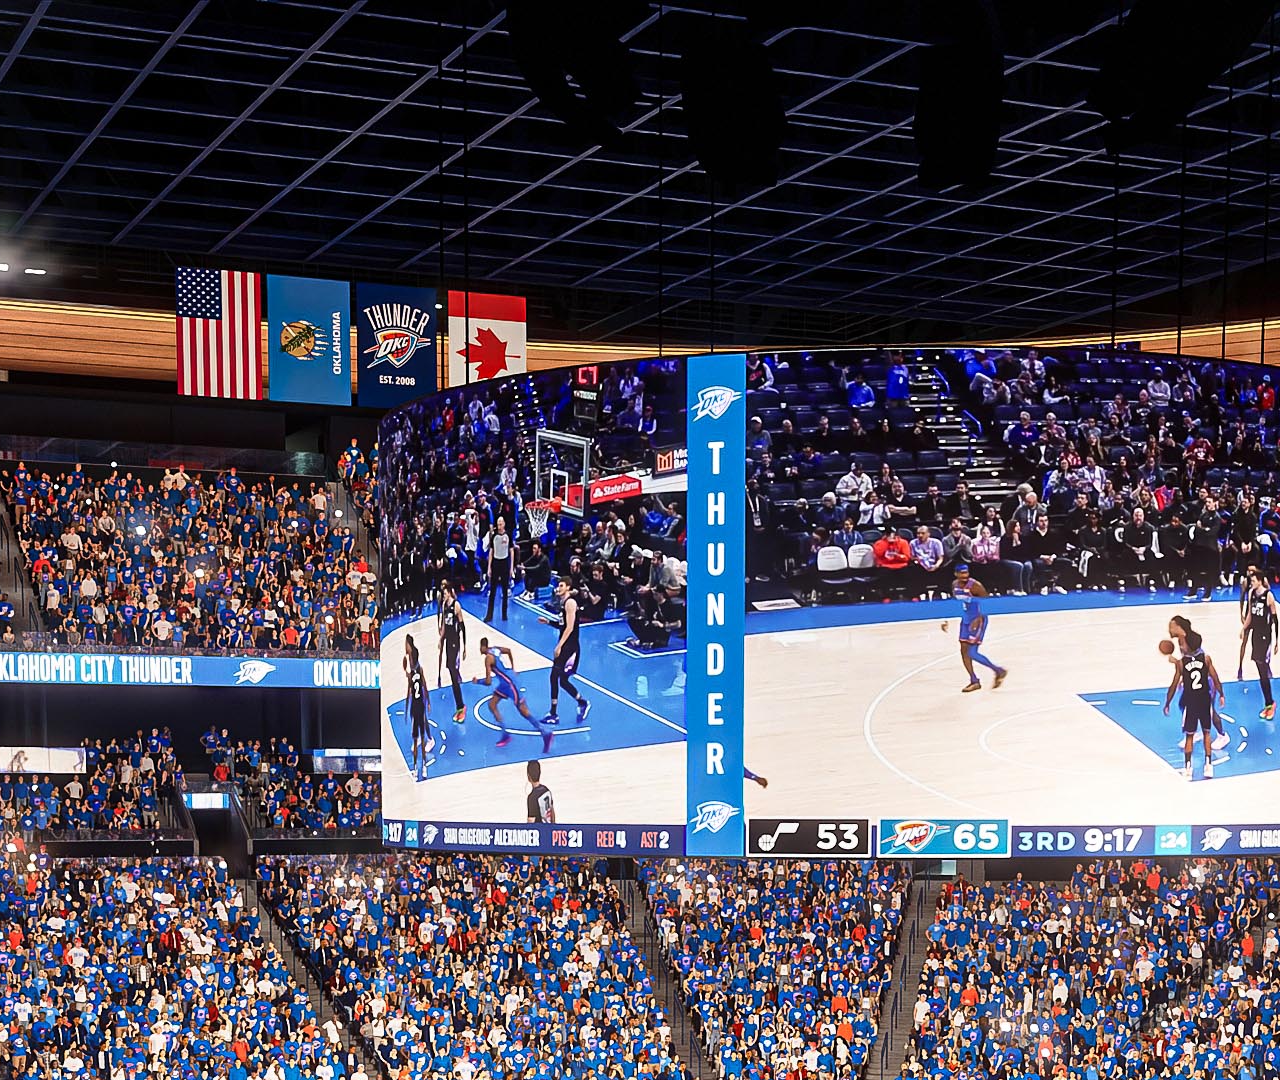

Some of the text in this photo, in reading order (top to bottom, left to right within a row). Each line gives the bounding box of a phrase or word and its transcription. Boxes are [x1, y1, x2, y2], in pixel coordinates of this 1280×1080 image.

[363, 303, 430, 334] THUNDER
[332, 311, 342, 376] OKLAHOMA
[378, 335, 410, 356] OKC
[379, 375, 416, 387] EST. 2008
[706, 440, 725, 776] THUNDER
[81, 655, 115, 683] CITY
[119, 656, 193, 684] THUNDER
[313, 660, 381, 687] OKLAHOM
[552, 830, 567, 847] PTS
[568, 830, 583, 848] 21
[596, 830, 614, 848] REB
[615, 830, 626, 848] 4
[641, 831, 657, 848] AST
[658, 831, 670, 849] 2
[816, 823, 860, 851] 53
[953, 823, 1000, 851] 65
[1018, 831, 1076, 851] 3RD
[1083, 827, 1144, 852] 9:17
